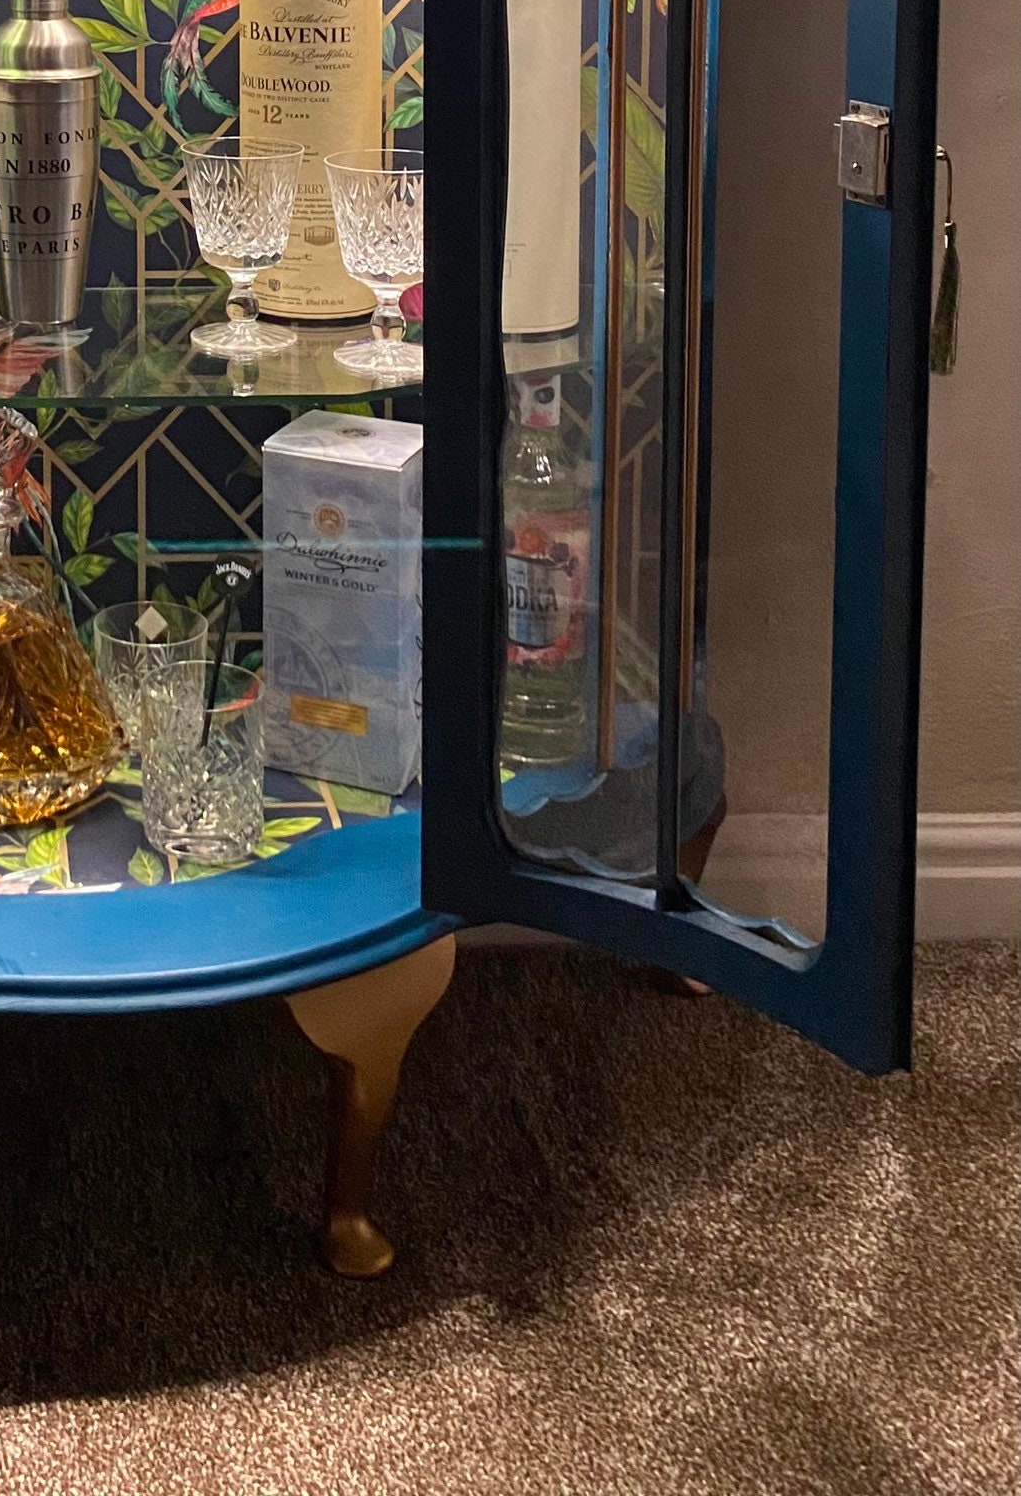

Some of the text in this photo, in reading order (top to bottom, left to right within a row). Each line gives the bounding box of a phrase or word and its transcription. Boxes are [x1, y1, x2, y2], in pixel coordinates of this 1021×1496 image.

[273, 7, 321, 23] Distilled
[250, 21, 351, 44] BALVENIE
[262, 104, 282, 125] 12
[28, 158, 71, 174] 1880
[17, 237, 80, 255] PARIS
[276, 531, 388, 571] Dalwhinnie
[341, 579, 376, 593] GOLD
[507, 585, 558, 611] ODKA
